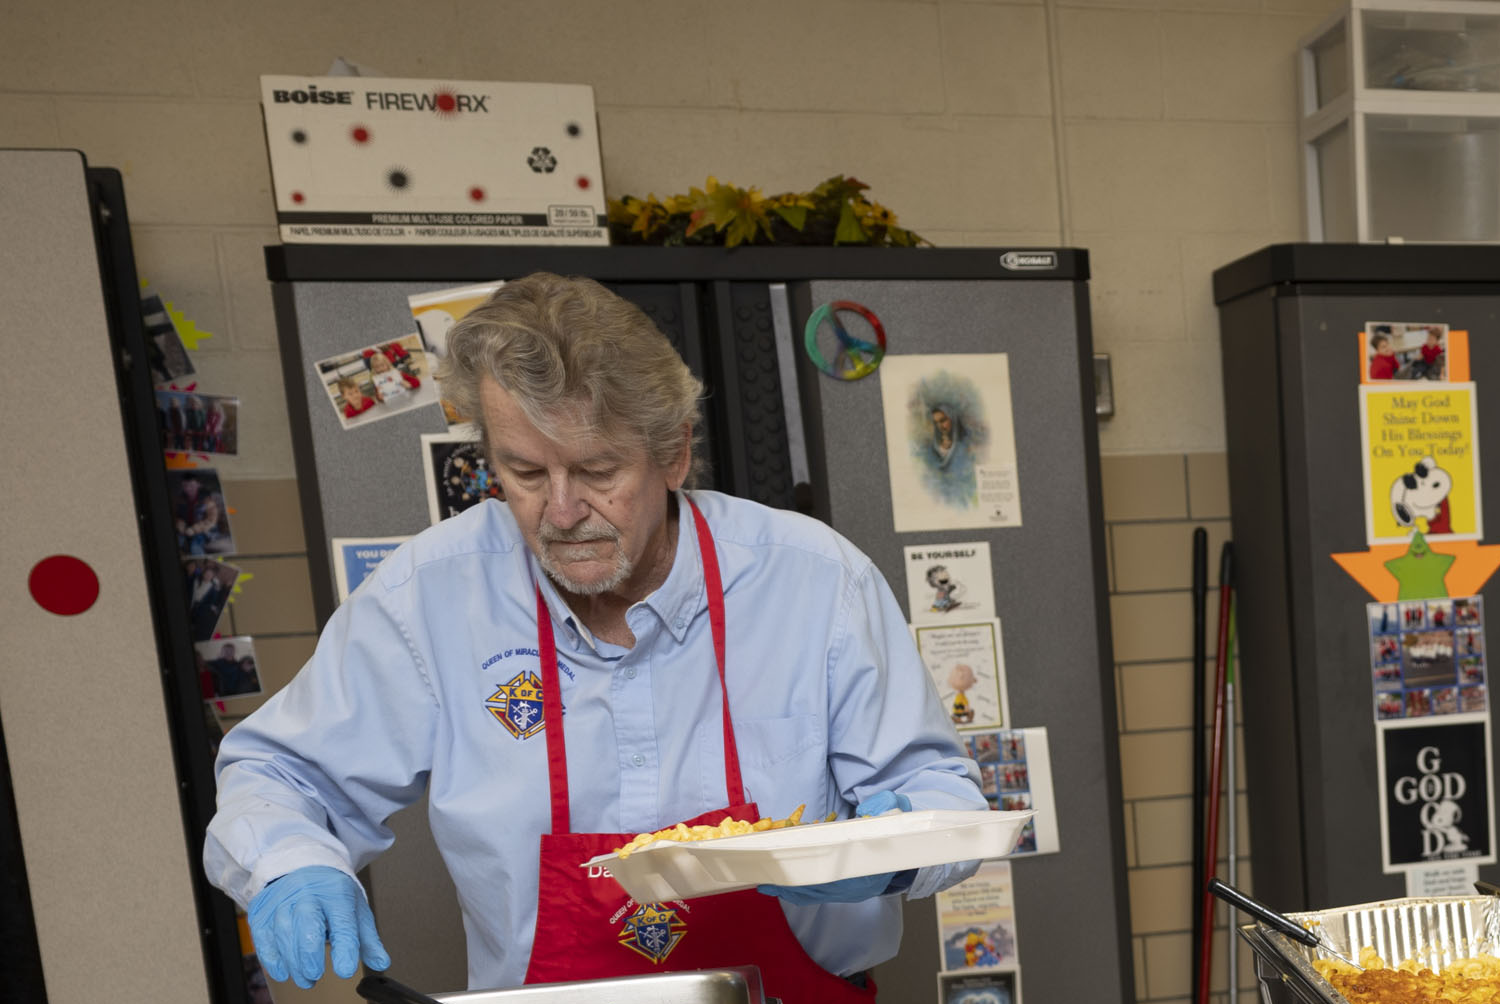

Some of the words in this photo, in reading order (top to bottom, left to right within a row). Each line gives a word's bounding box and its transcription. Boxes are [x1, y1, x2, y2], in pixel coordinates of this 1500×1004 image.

[372, 214, 410, 224] PREMIUM
[411, 214, 454, 225] MULTI-USE
[455, 215, 494, 225] COLORED
[495, 215, 523, 226] PAPER
[1392, 396, 1418, 412] May
[1421, 394, 1451, 408] God
[1383, 412, 1417, 425] Shine
[1421, 411, 1460, 424] Down
[1381, 428, 1404, 442] His
[1407, 428, 1463, 446] Blessings
[1372, 446, 1394, 458] On
[1397, 444, 1424, 457] You
[355, 550, 379, 560] YOU
[911, 551, 924, 561] BE
[927, 549, 976, 560] YOURSELF
[482, 652, 503, 670] QUEEN
[504, 649, 514, 658] OF
[557, 660, 576, 681] MEDAL
[509, 688, 518, 698] K
[536, 690, 544, 700] C
[1394, 772, 1467, 805] GOD
[609, 905, 628, 925] QUEEN
[637, 916, 647, 926] K
[658, 913, 667, 922] C
